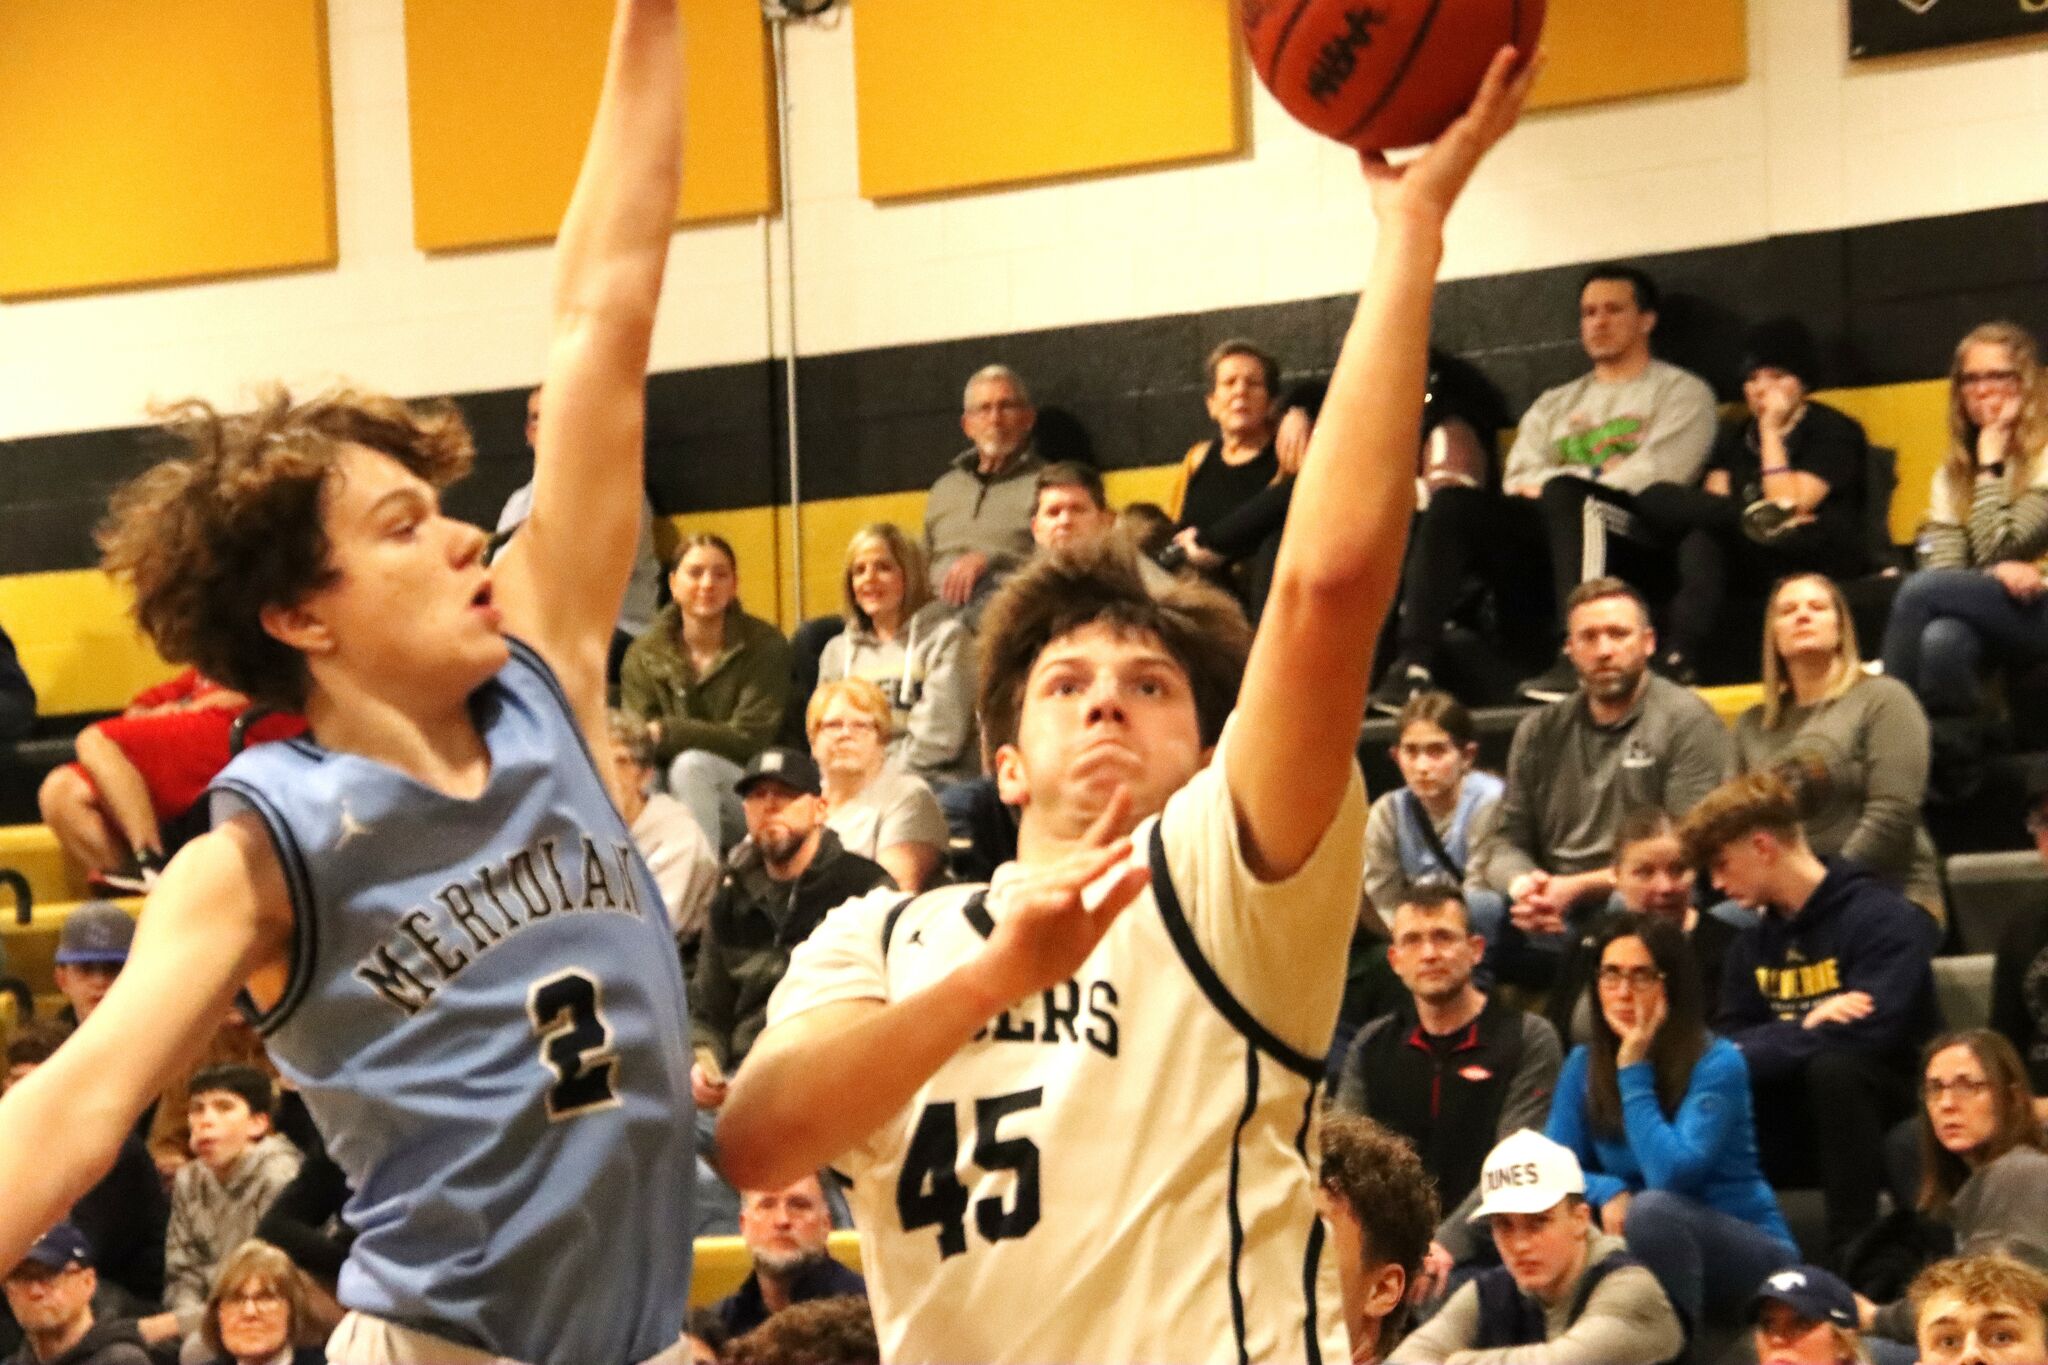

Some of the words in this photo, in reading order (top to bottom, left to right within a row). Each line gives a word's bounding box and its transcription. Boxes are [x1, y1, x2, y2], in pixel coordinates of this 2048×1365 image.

[353, 835, 645, 1017] MERIDIAN
[526, 967, 623, 1121] 2
[972, 975, 1118, 1059] ERS
[896, 1085, 1045, 1262] 45
